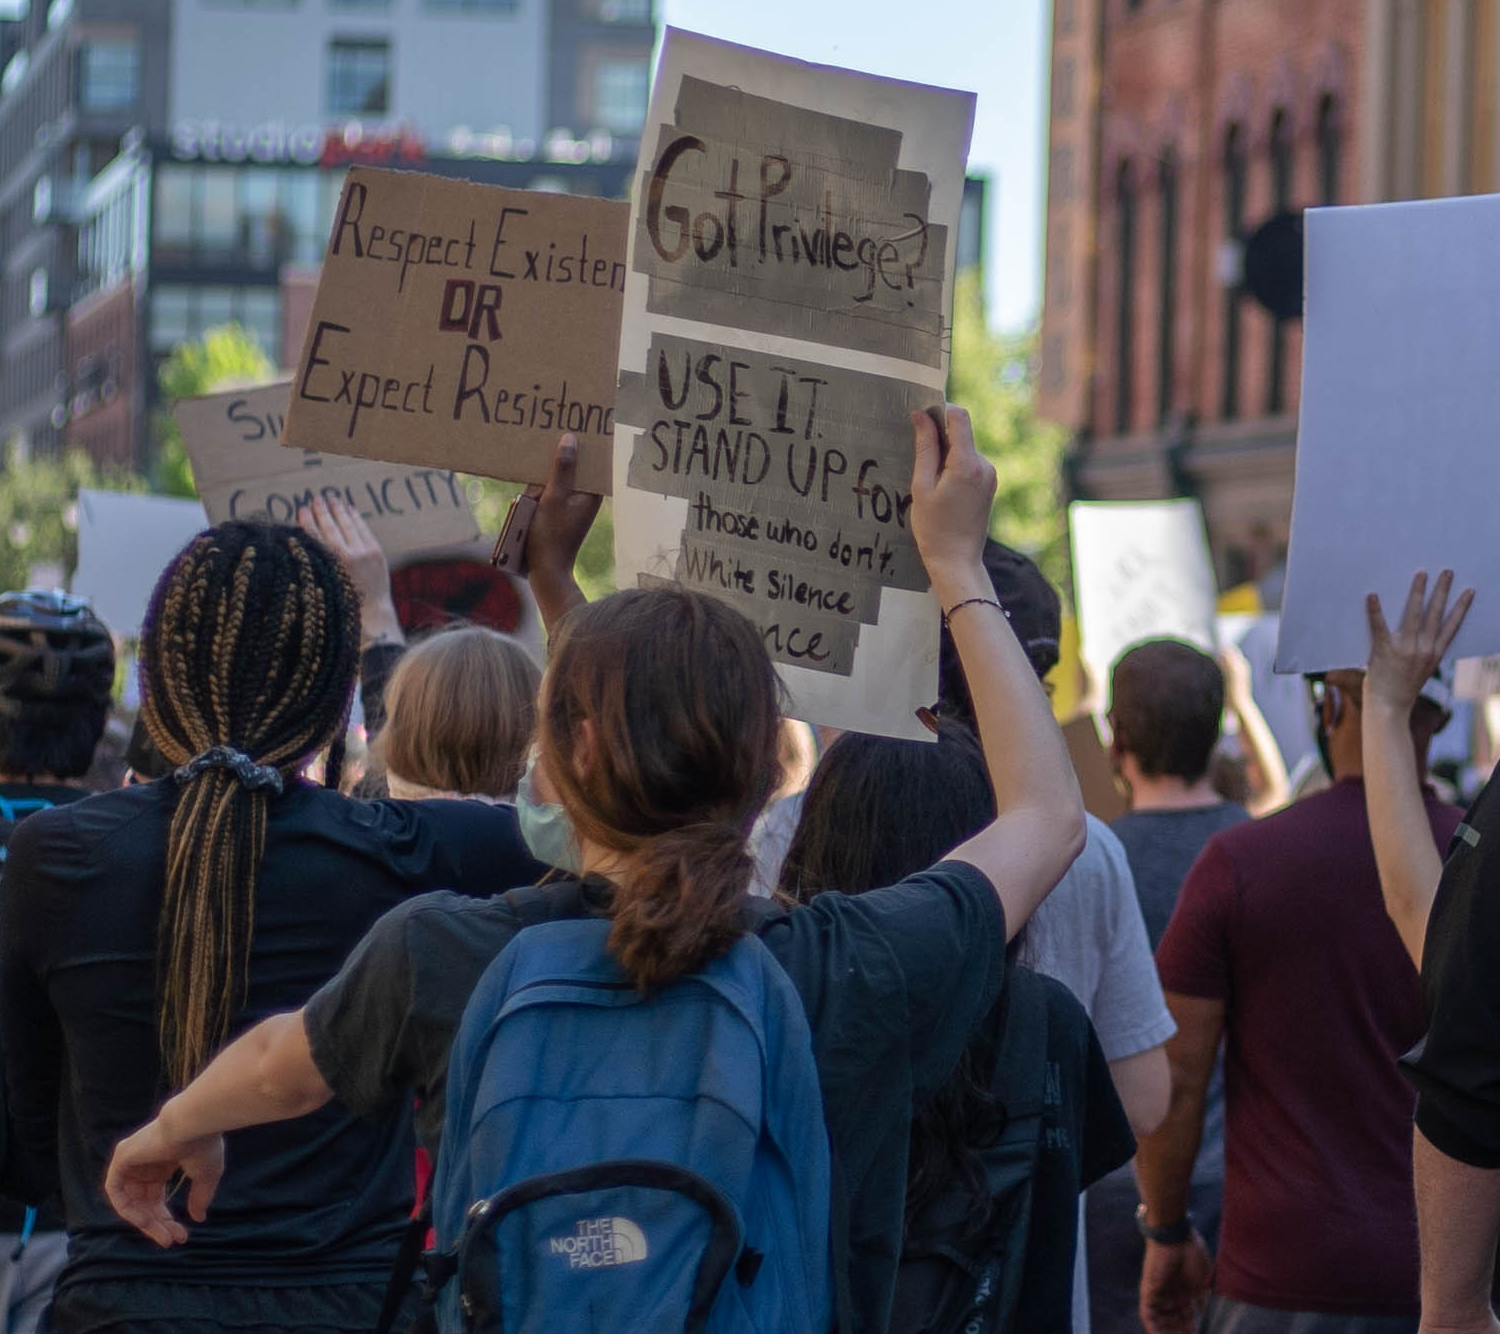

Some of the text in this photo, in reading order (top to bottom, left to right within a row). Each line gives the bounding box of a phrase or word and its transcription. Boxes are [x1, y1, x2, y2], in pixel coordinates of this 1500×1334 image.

[332, 182, 477, 293] Respect
[646, 136, 929, 307] Got Privilege?
[438, 279, 503, 342] OR
[300, 320, 436, 438] Expect
[658, 348, 753, 426] USE
[650, 419, 913, 529] STAND UP for
[692, 490, 759, 540] those
[767, 518, 818, 552] who
[684, 543, 754, 594] White
[551, 1234, 613, 1255] NORTH
[576, 1219, 612, 1236] THE
[570, 1251, 614, 1268] FACE
